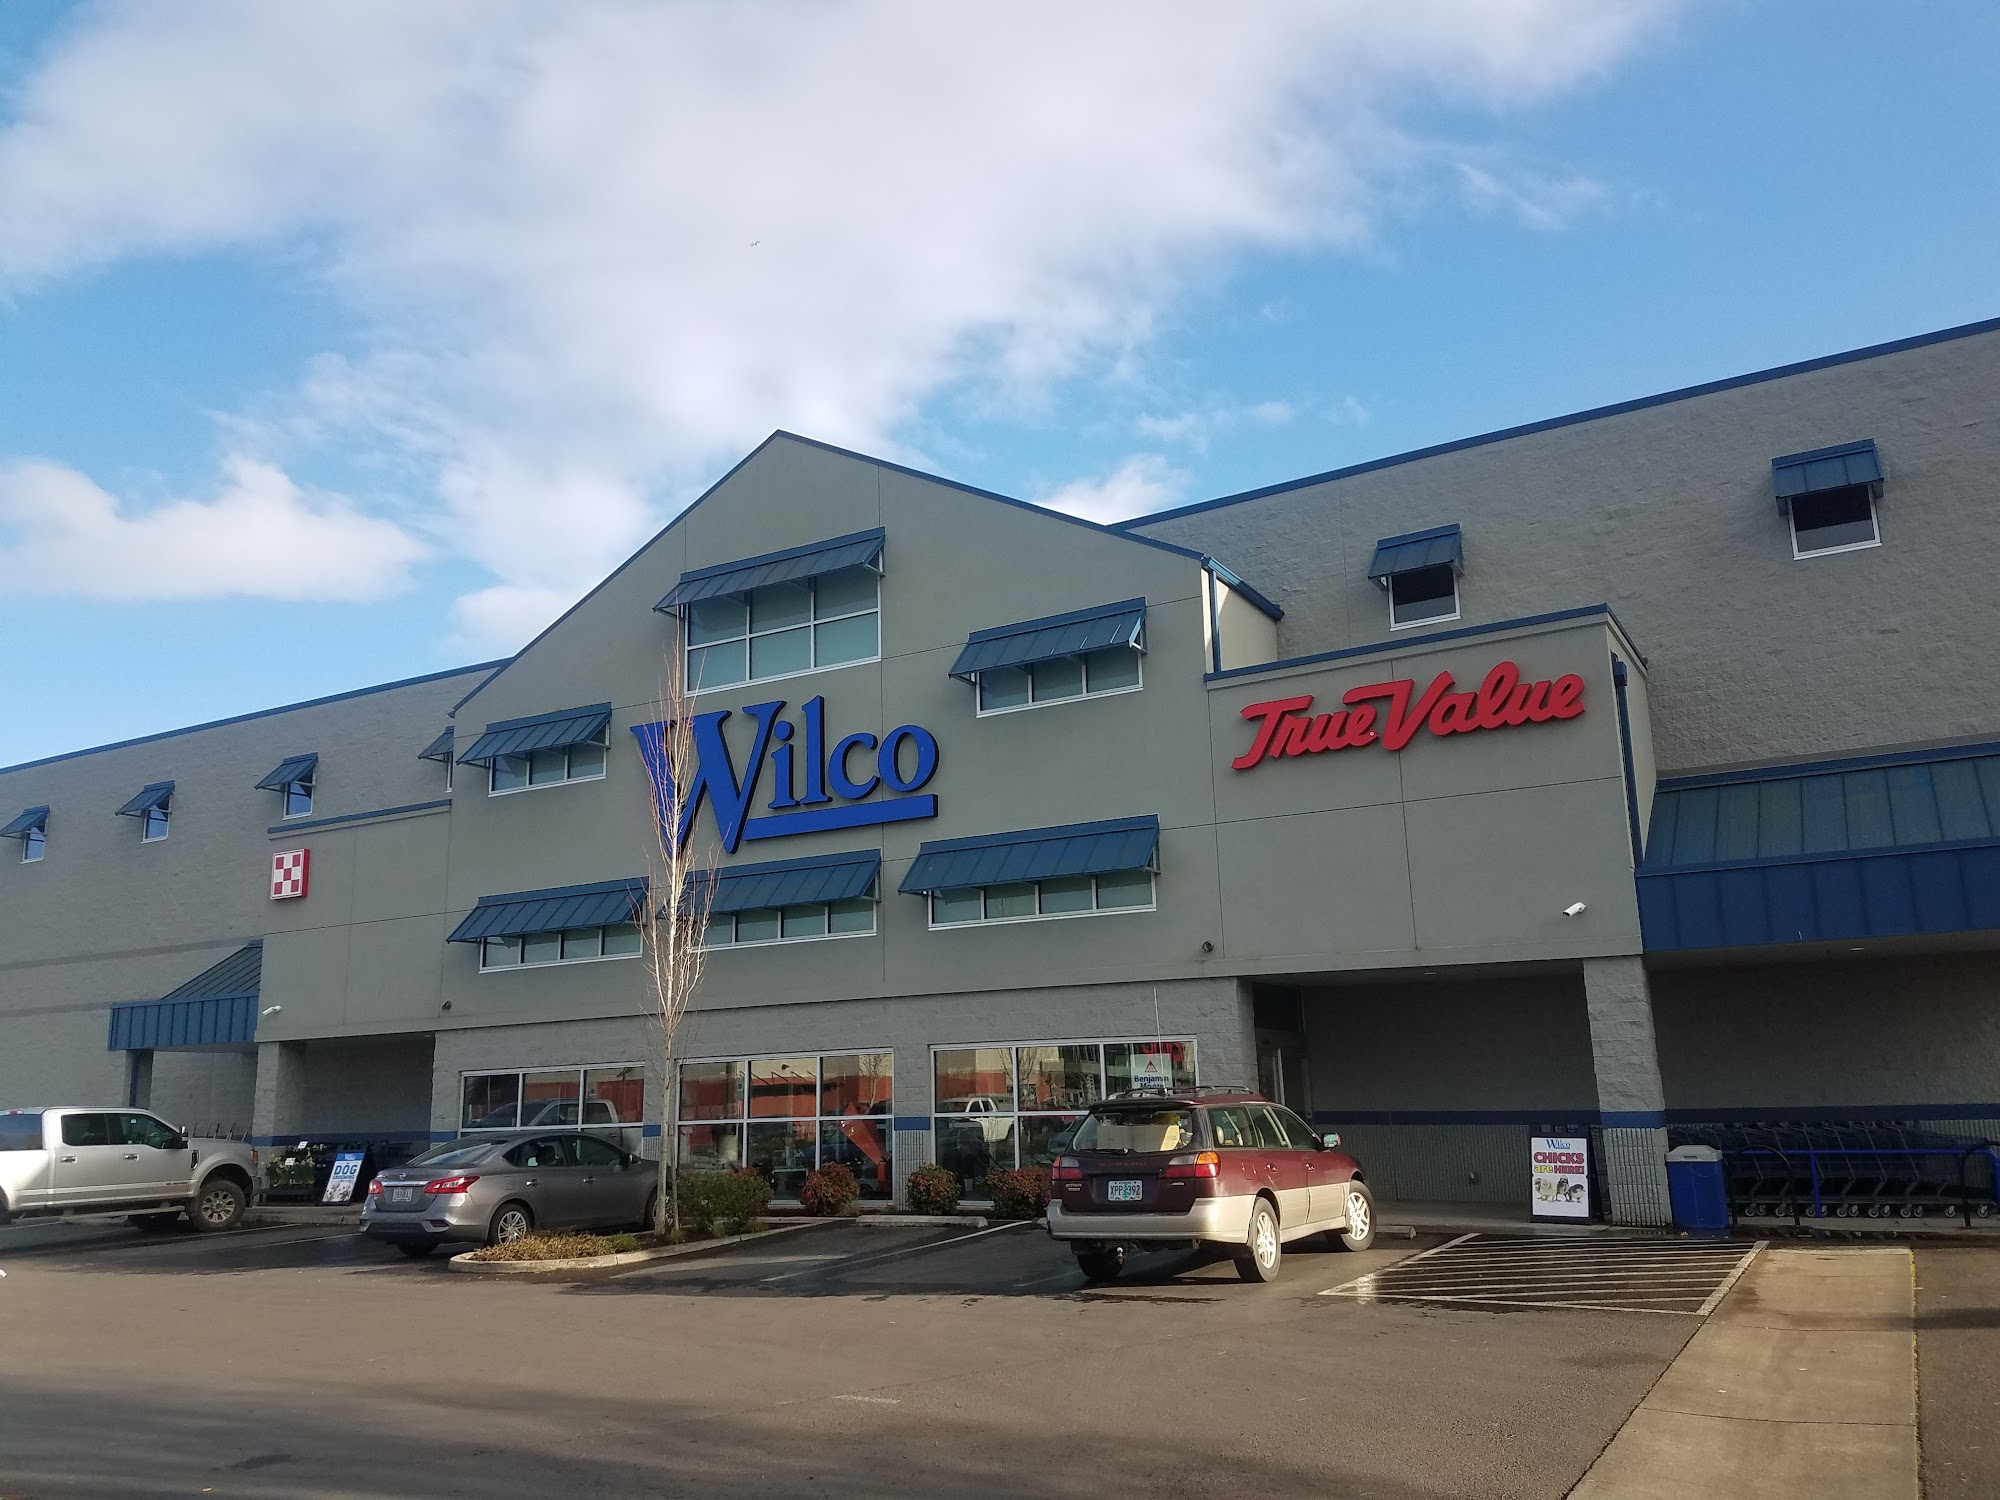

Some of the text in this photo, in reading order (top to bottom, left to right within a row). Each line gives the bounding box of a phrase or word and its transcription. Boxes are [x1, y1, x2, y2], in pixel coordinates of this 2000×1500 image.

[1231, 661, 1586, 770] True Value
[629, 694, 939, 858] Wilco
[1134, 1074, 1169, 1083] Benjamn
[1546, 1139, 1571, 1149] Wilco
[1533, 1152, 1585, 1164] CHICKS
[334, 1164, 358, 1175] DOG
[1534, 1165, 1585, 1174] are HERE!
